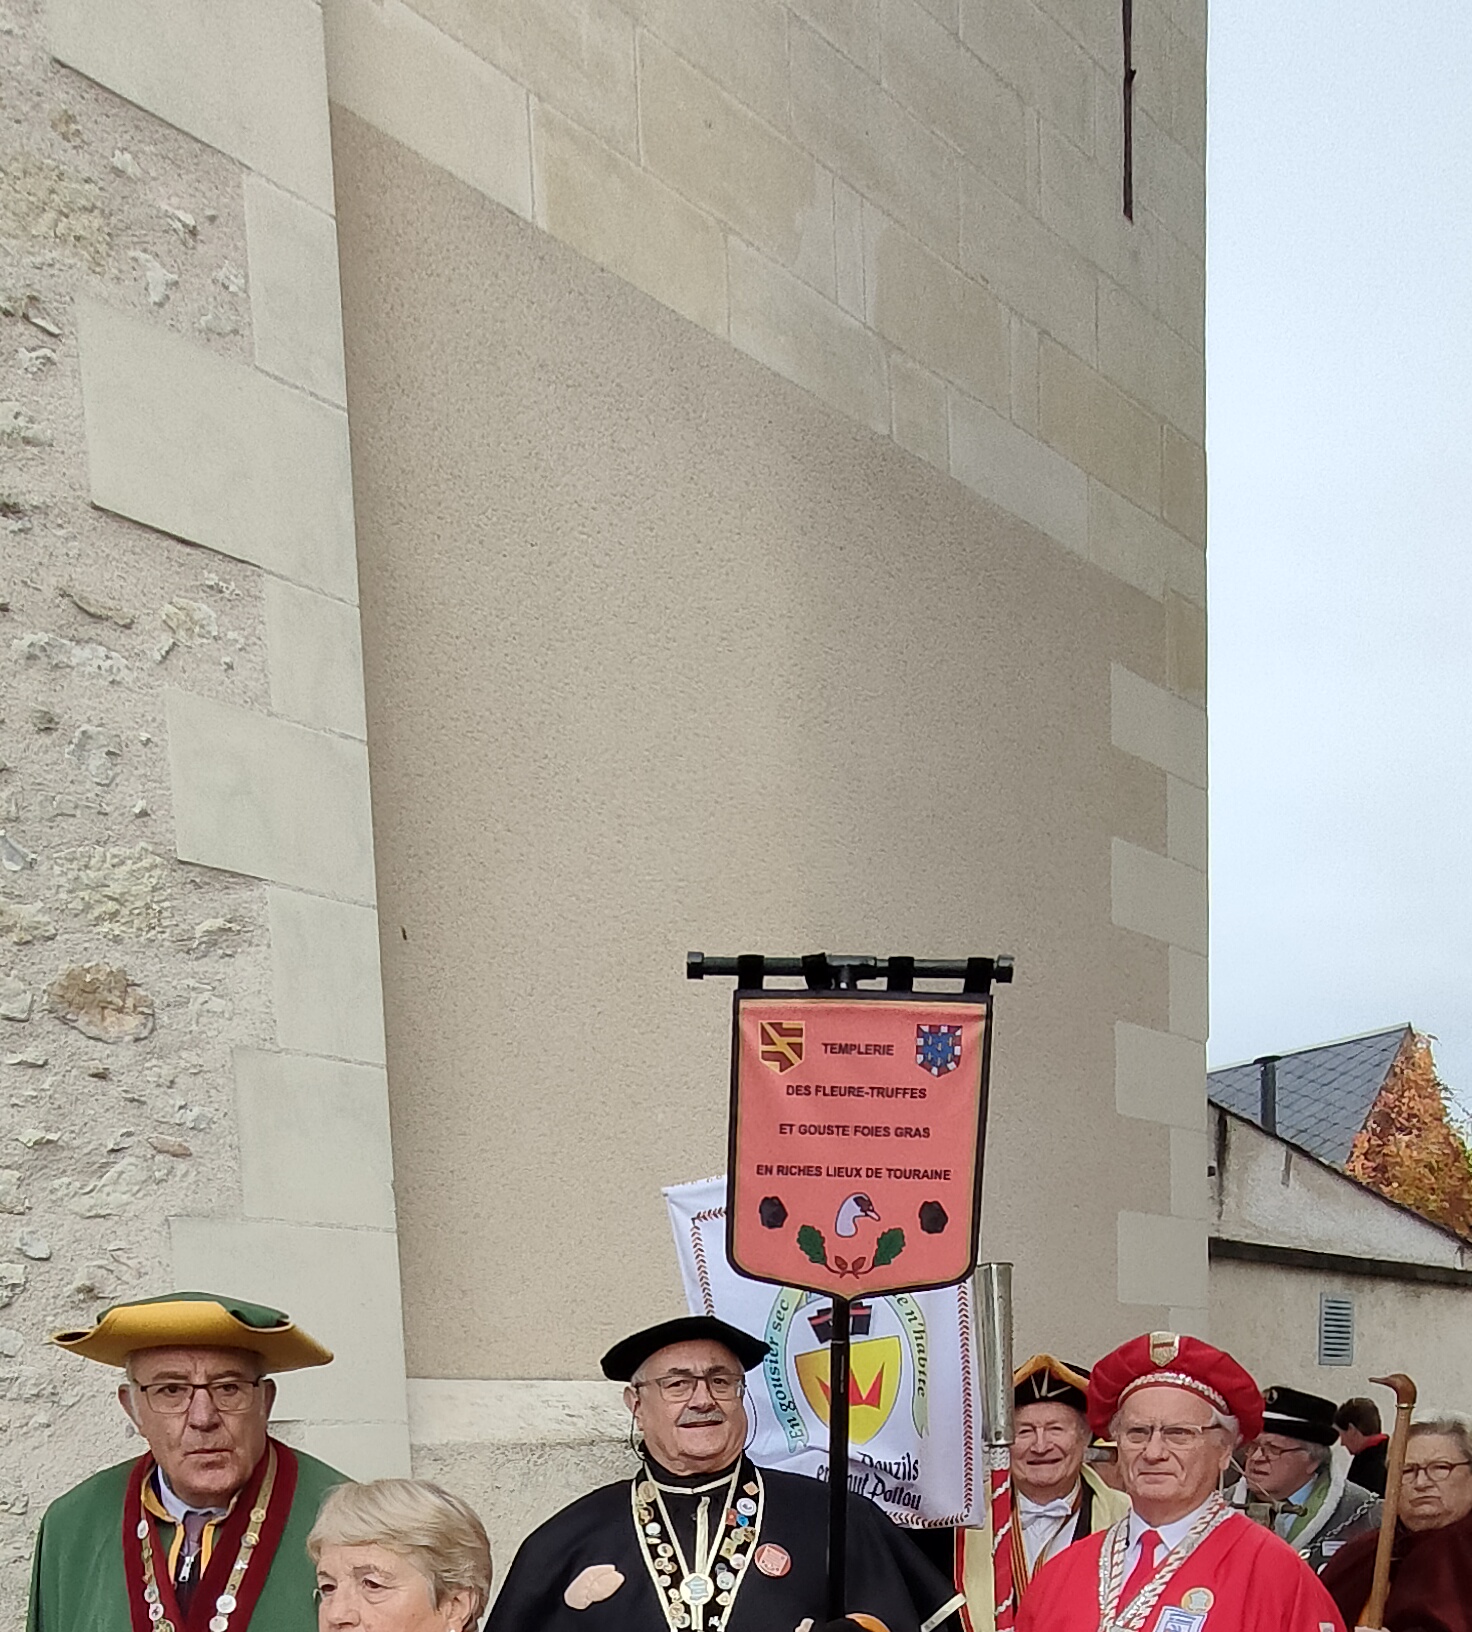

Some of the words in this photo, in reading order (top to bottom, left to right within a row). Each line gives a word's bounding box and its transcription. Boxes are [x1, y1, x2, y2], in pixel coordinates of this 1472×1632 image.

[821, 1042, 895, 1056] TEMPLERIE
[786, 1084, 812, 1097] DES
[814, 1085, 927, 1099] FLEURE-TRUFFES
[779, 1123, 796, 1135] ET
[798, 1124, 850, 1136] GOUSTE
[853, 1125, 891, 1138] FOIES
[894, 1126, 930, 1139] GRAS
[756, 1164, 774, 1176] EN
[776, 1165, 823, 1178] RICHES
[826, 1166, 862, 1179] LIEUX
[865, 1167, 883, 1179] DE
[885, 1168, 951, 1181] TOURAINE
[772, 1299, 790, 1332] sec
[786, 1416, 805, 1439] En
